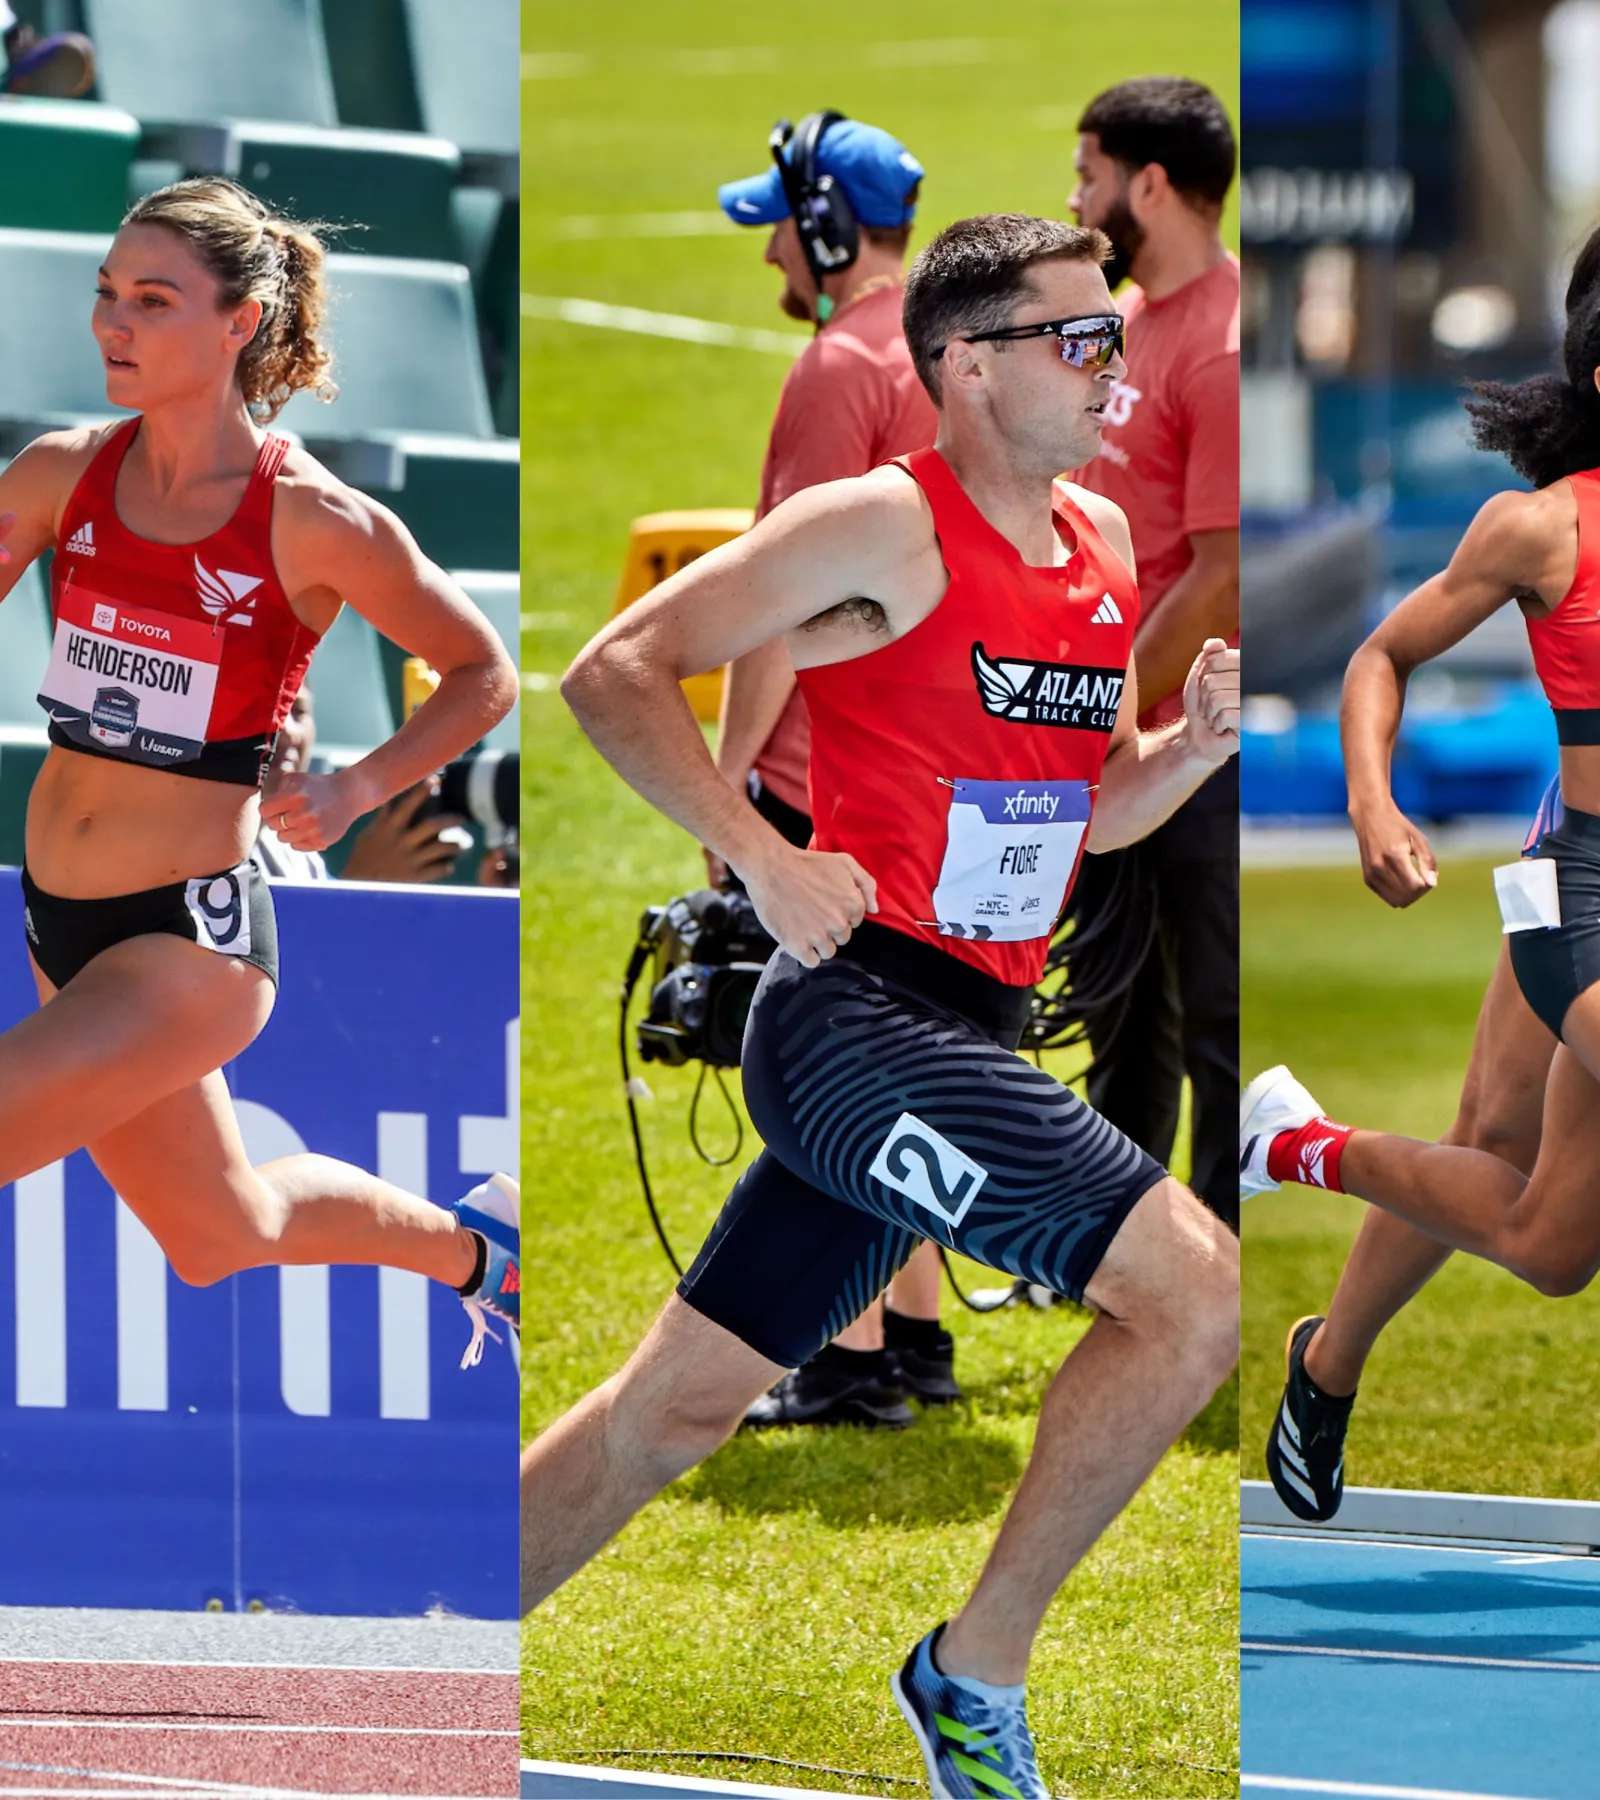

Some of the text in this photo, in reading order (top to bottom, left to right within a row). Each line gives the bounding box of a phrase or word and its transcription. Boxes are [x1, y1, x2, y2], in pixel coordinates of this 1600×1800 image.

[66, 541, 97, 557] adidas
[119, 616, 171, 642] TOYOTA
[67, 632, 193, 696] HENDERSON
[1035, 704, 1082, 723] TRACK
[153, 744, 184, 757] USATF
[1002, 789, 1061, 821] xfinity
[999, 843, 1043, 876] FIORE
[197, 873, 242, 946] 9
[975, 908, 996, 916] GRAND
[986, 900, 1002, 910] NYC
[886, 1133, 976, 1217] 2
